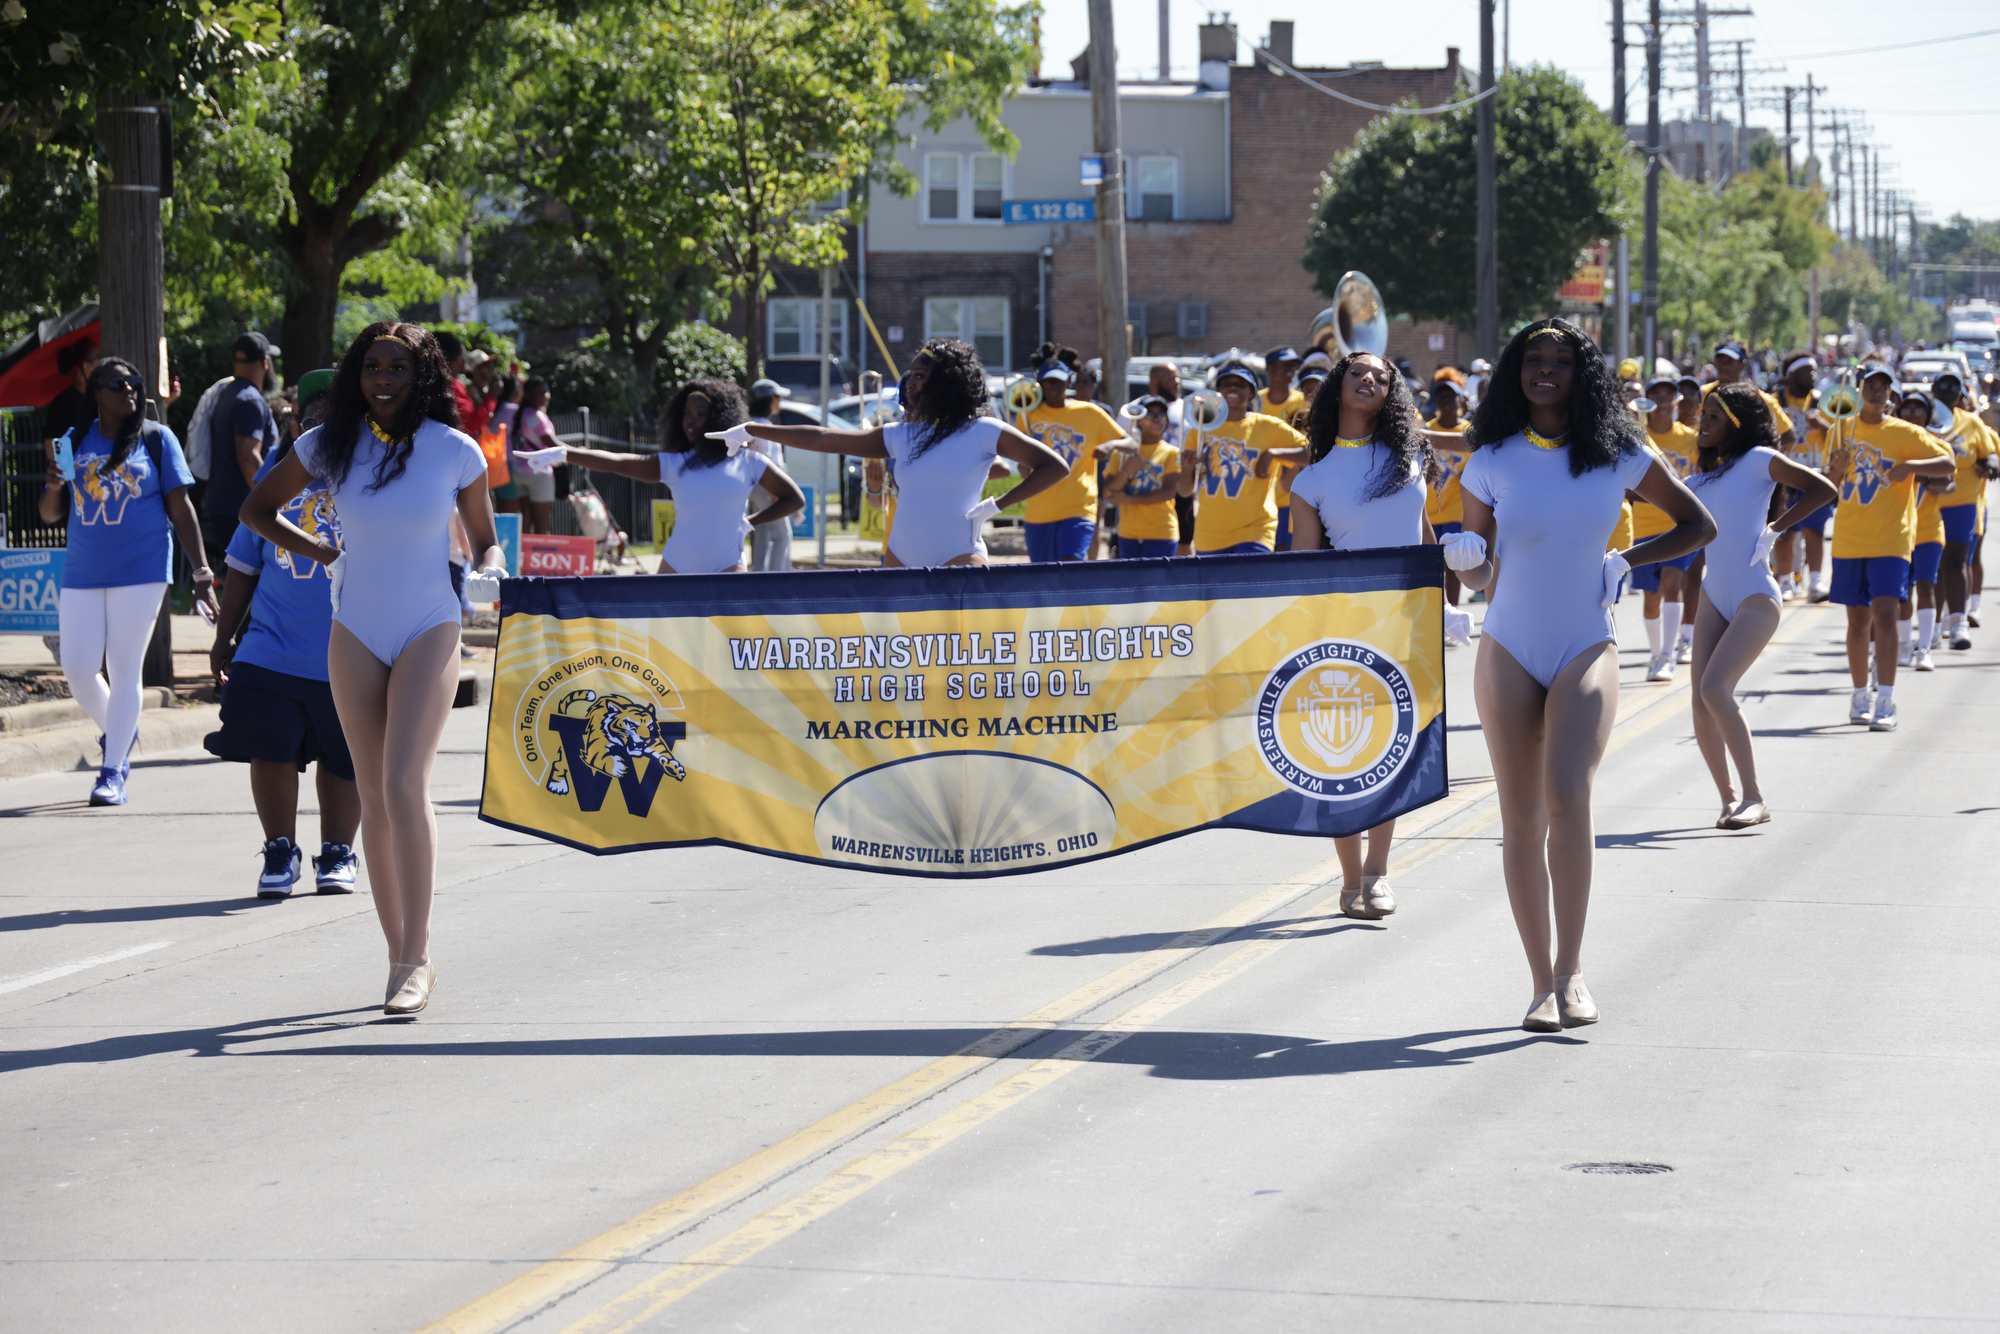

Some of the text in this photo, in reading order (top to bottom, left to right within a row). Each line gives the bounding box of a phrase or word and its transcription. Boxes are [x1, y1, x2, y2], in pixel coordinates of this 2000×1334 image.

[1011, 202, 1086, 221] E. 132 St
[529, 552, 573, 570] SON
[574, 554, 590, 575] J.
[11, 615, 35, 625] WARD
[729, 623, 1194, 670] WARRENSVILLE HEIGHTS
[834, 669, 1090, 702] HIGH SCHOOL
[520, 655, 671, 762] One Team, One Vision, One Goal
[1259, 644, 1412, 793] WARRENSVILLE HEIGHTS HIGH SCHOOL
[1296, 692, 1375, 714] H S
[805, 712, 1118, 740] MARCHING MACHINE
[1315, 704, 1356, 743] WH
[549, 713, 687, 818] W
[831, 831, 1098, 864] WARRENSVILLE HEIGHTS, OHIO
